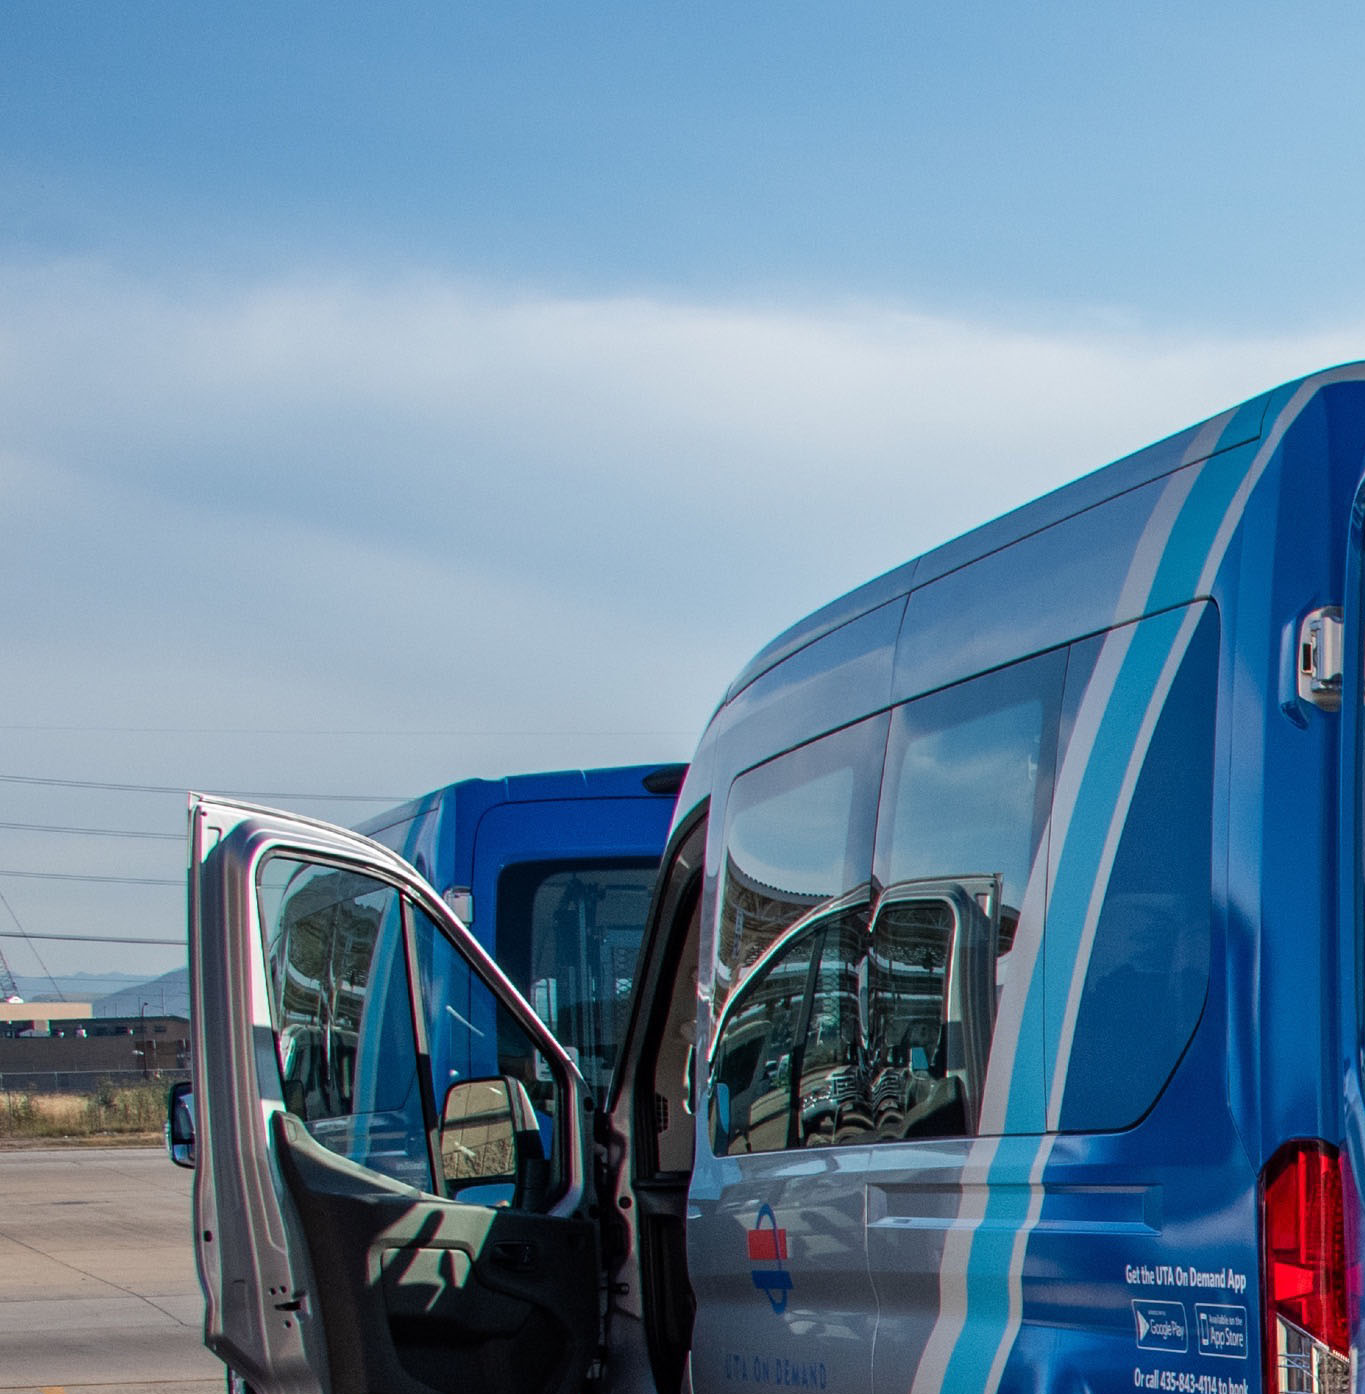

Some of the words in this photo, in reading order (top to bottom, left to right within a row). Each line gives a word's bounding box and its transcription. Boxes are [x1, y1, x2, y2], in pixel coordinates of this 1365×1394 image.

[1125, 1264, 1140, 1285] Get
[1140, 1265, 1155, 1285] the
[1155, 1266, 1175, 1286] UTA
[1175, 1266, 1188, 1287] On
[1189, 1266, 1226, 1289] Demand
[1227, 1268, 1247, 1294] App
[1150, 1319, 1171, 1340] Google
[1171, 1320, 1184, 1340] Play
[1210, 1327, 1224, 1349] App
[1224, 1327, 1243, 1348] Store
[725, 1353, 748, 1381] UTA
[752, 1356, 769, 1383] ON
[775, 1358, 827, 1390] DEMAND
[1134, 1368, 1144, 1387] Or
[1145, 1369, 1159, 1389] call
[1160, 1371, 1218, 1394] 435-843-4114
